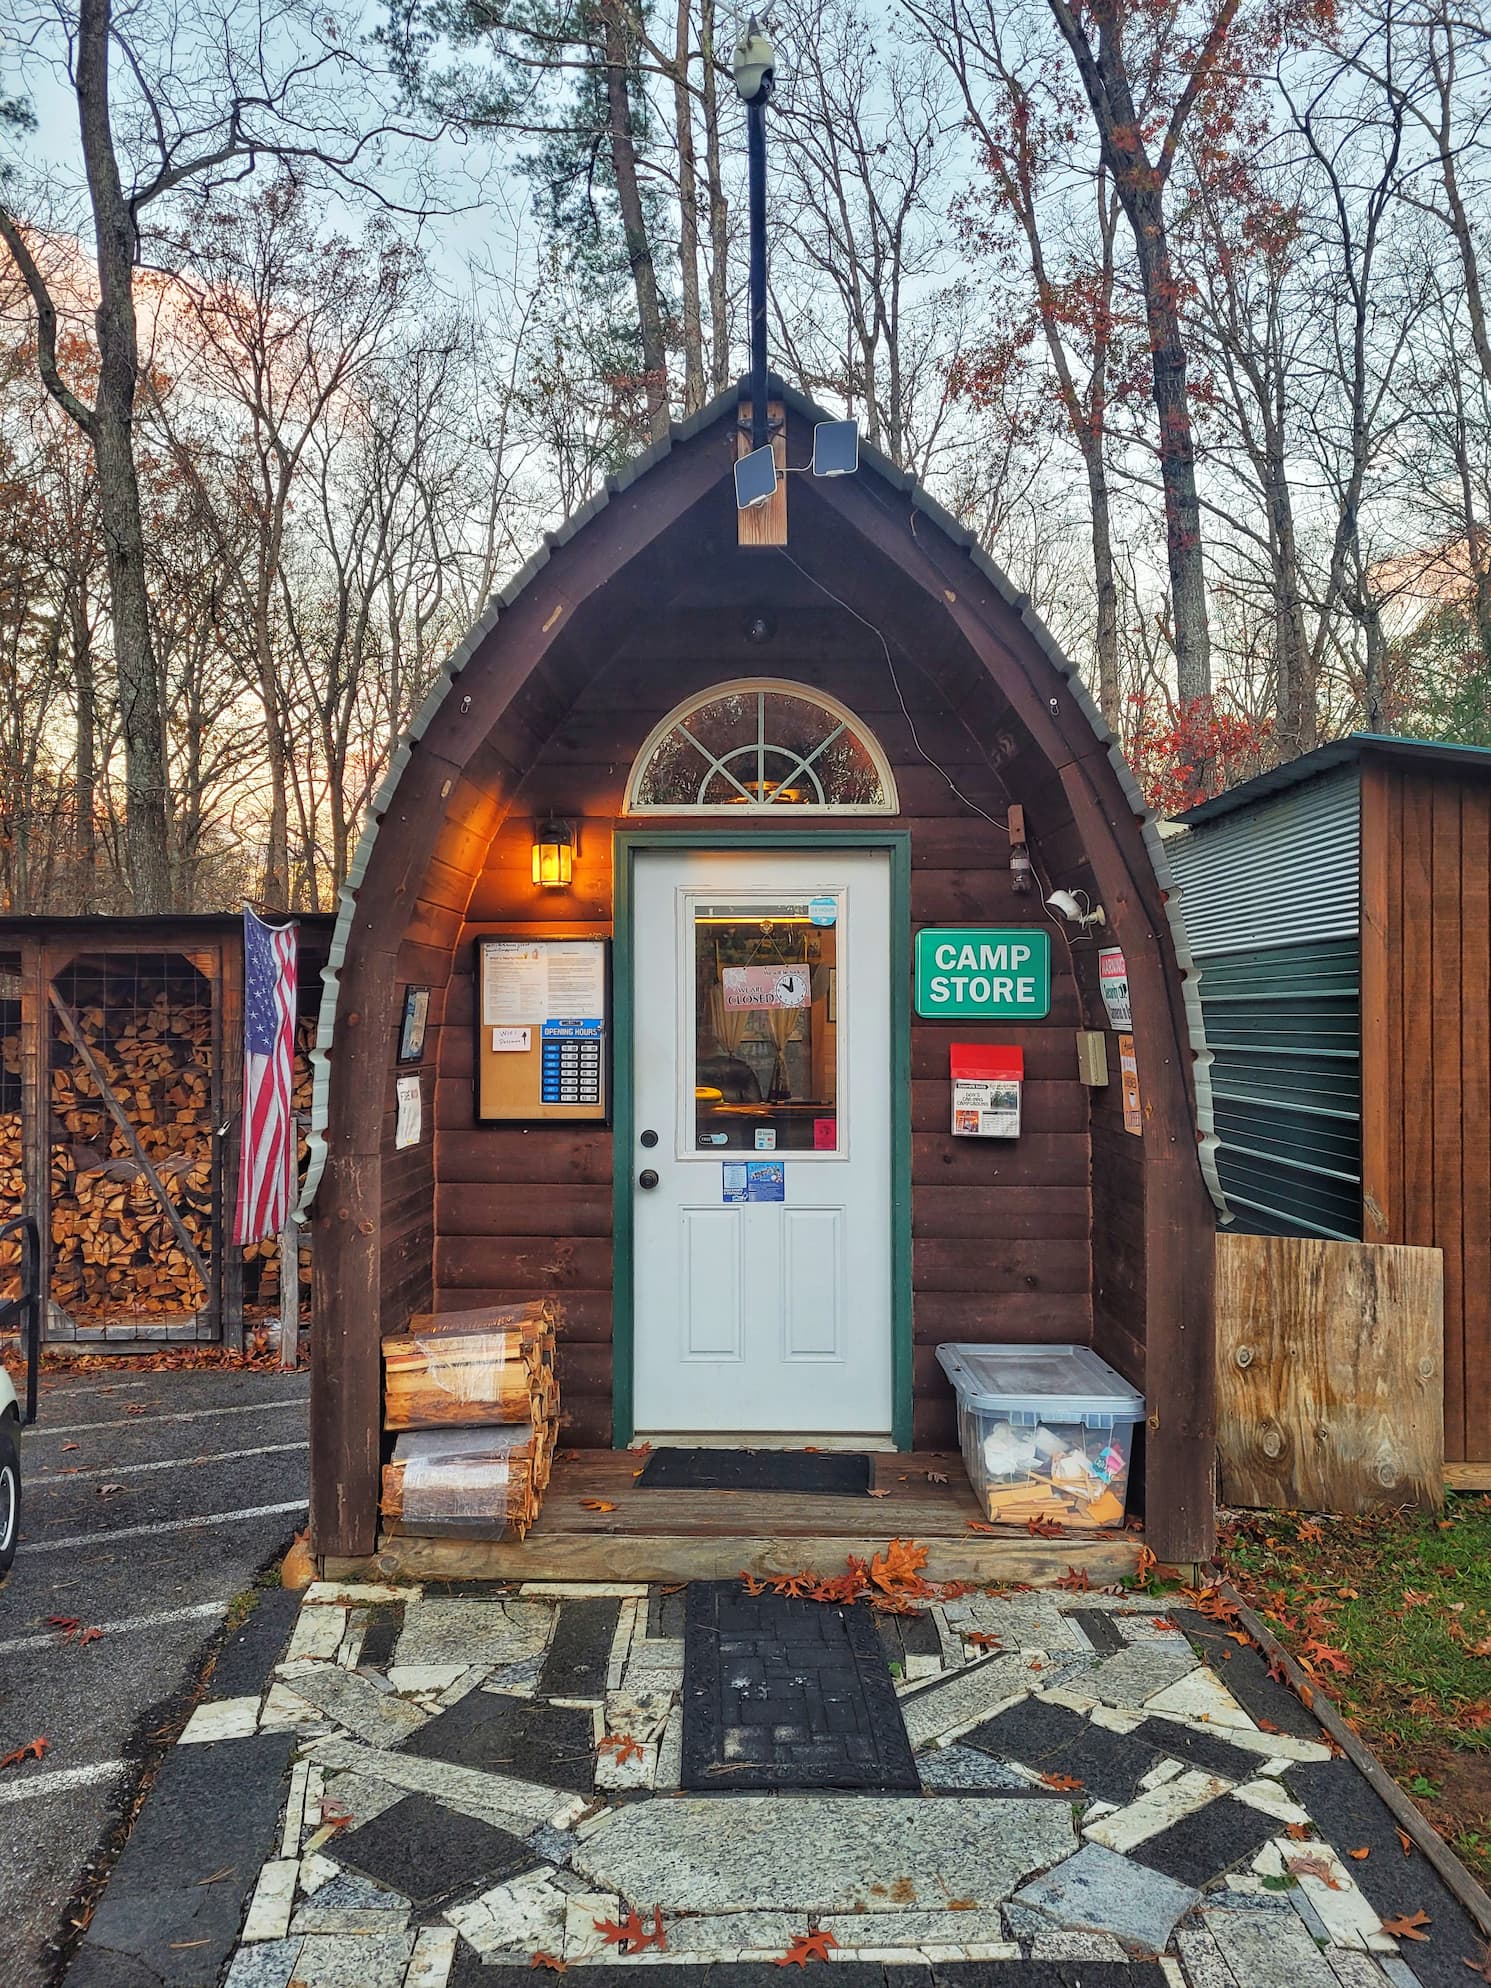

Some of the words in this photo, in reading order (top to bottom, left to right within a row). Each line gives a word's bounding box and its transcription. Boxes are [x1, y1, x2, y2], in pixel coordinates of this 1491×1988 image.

[935, 944, 1031, 971] CAMP
[737, 986, 749, 994] WE
[750, 985, 763, 993] ARE
[930, 976, 1036, 1003] STORE
[728, 993, 775, 1005] CLOSED
[544, 1028, 574, 1036] OPENING
[574, 1027, 598, 1036] HOURS
